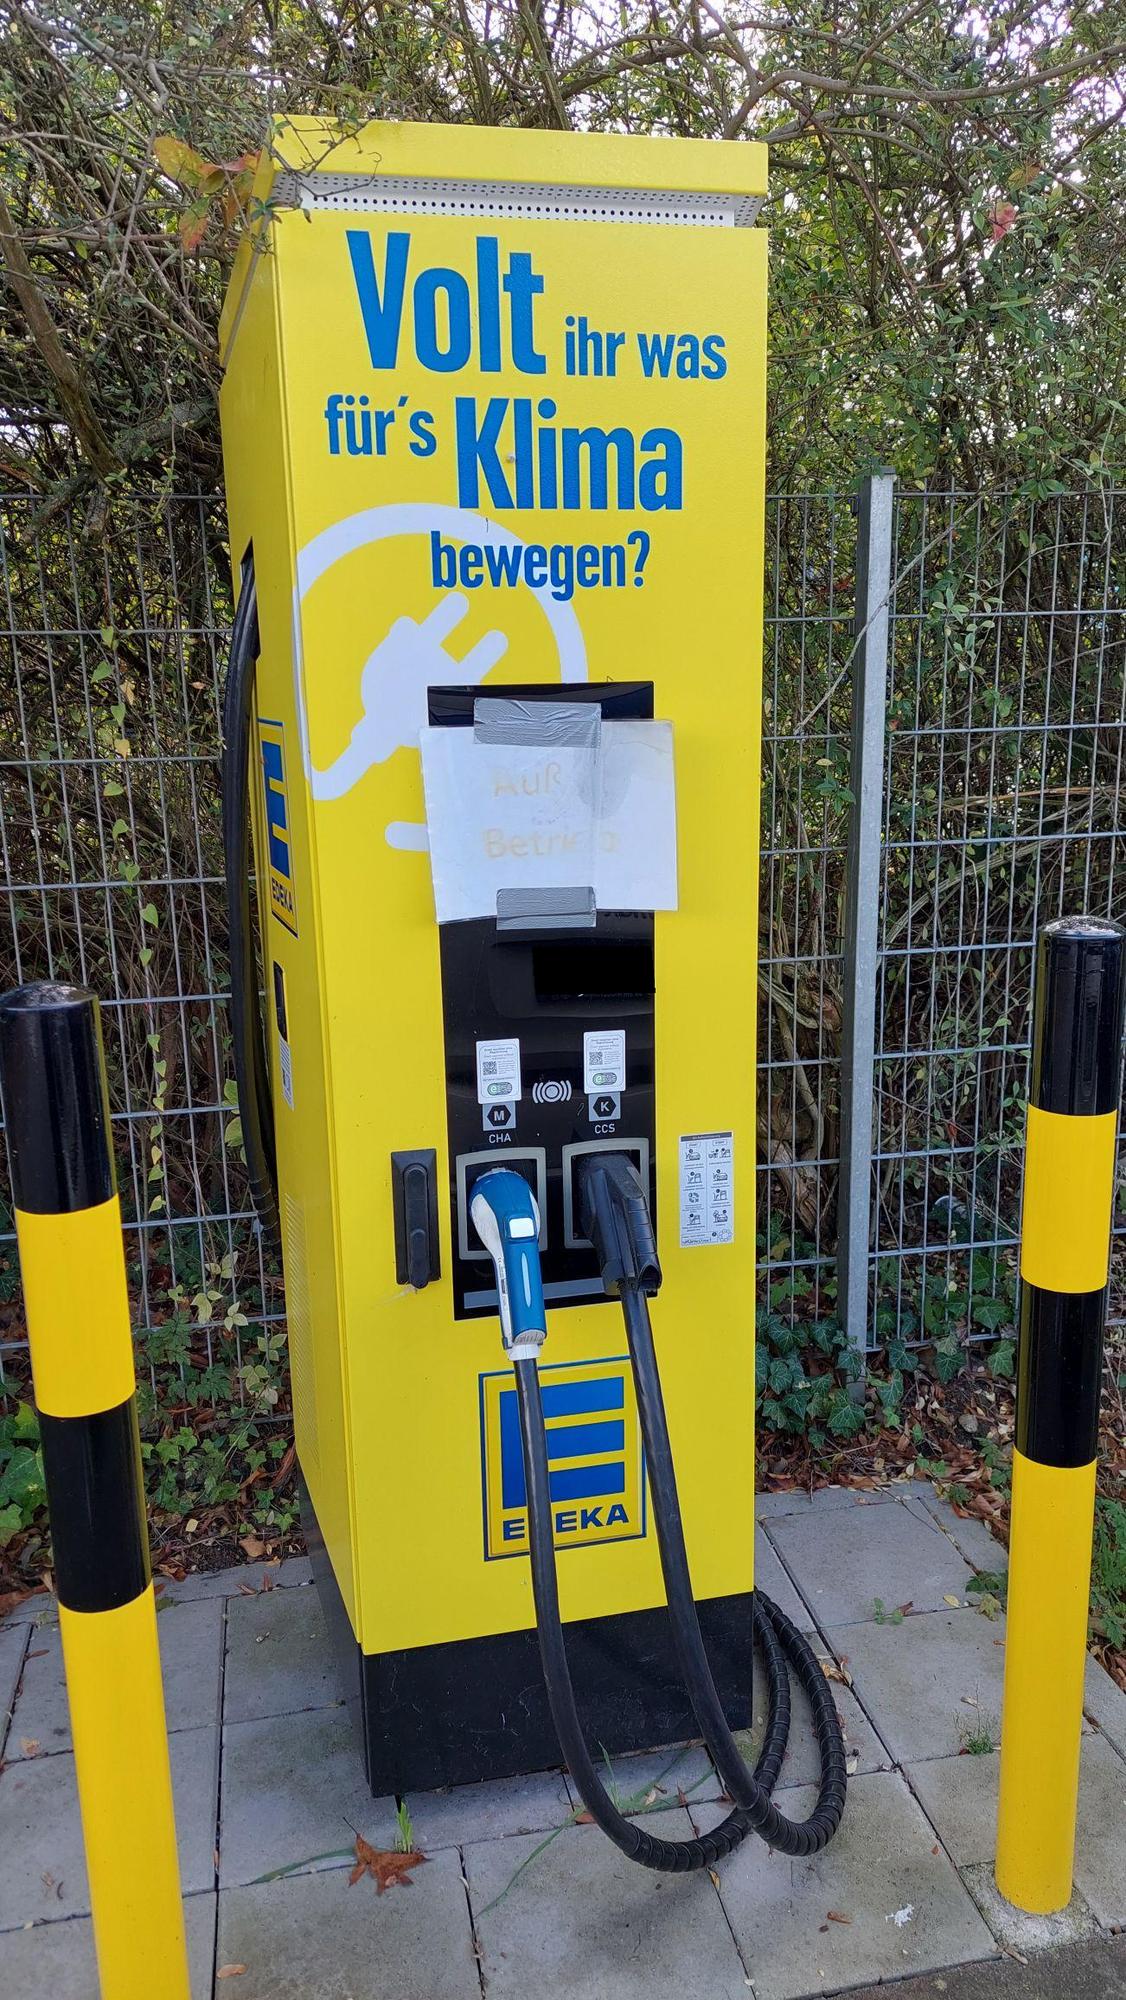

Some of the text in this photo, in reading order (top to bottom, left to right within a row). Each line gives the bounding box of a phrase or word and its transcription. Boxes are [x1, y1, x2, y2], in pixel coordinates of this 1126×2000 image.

[346, 230, 728, 379] Volt ihr was
[455, 397, 683, 511] Klima
[430, 530, 651, 601] bewegen?
[493, 1110, 505, 1121] M
[600, 1101, 610, 1112] K
[488, 1133, 512, 1144] CHA
[594, 1123, 616, 1134] CCS
[503, 1504, 629, 1541] EEKA
